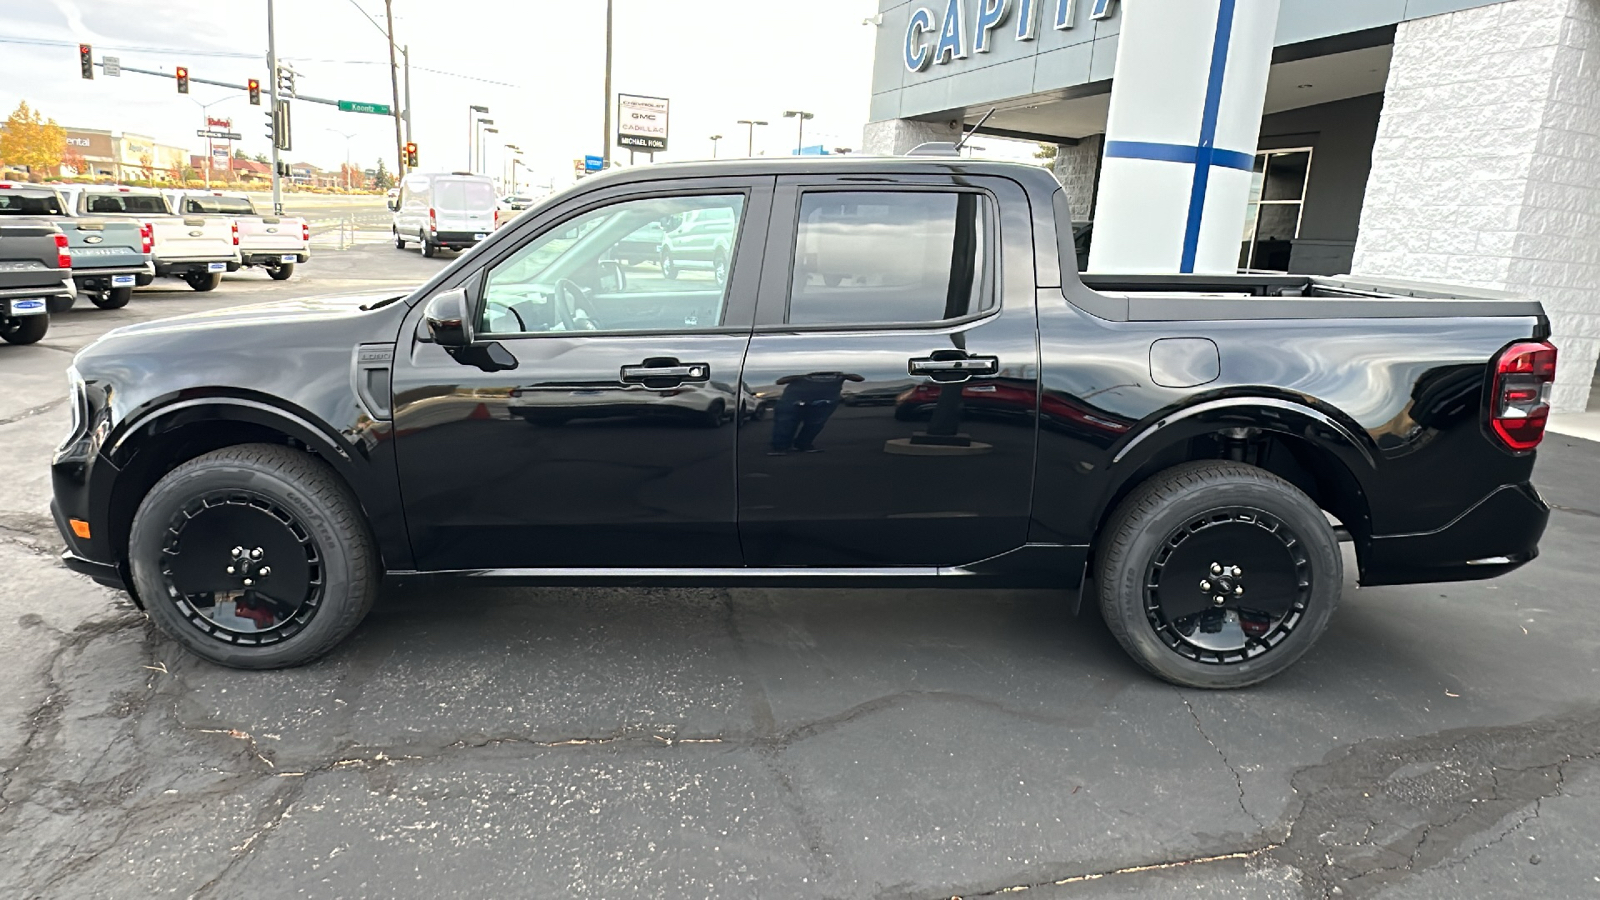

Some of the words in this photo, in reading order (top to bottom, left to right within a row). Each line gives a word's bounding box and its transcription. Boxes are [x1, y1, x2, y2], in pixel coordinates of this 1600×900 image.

[351, 103, 375, 113] Koontz
[631, 113, 656, 121] GMC
[622, 124, 665, 134] CADILLAC
[66, 137, 90, 147] ental
[621, 137, 647, 146] MICHAEL
